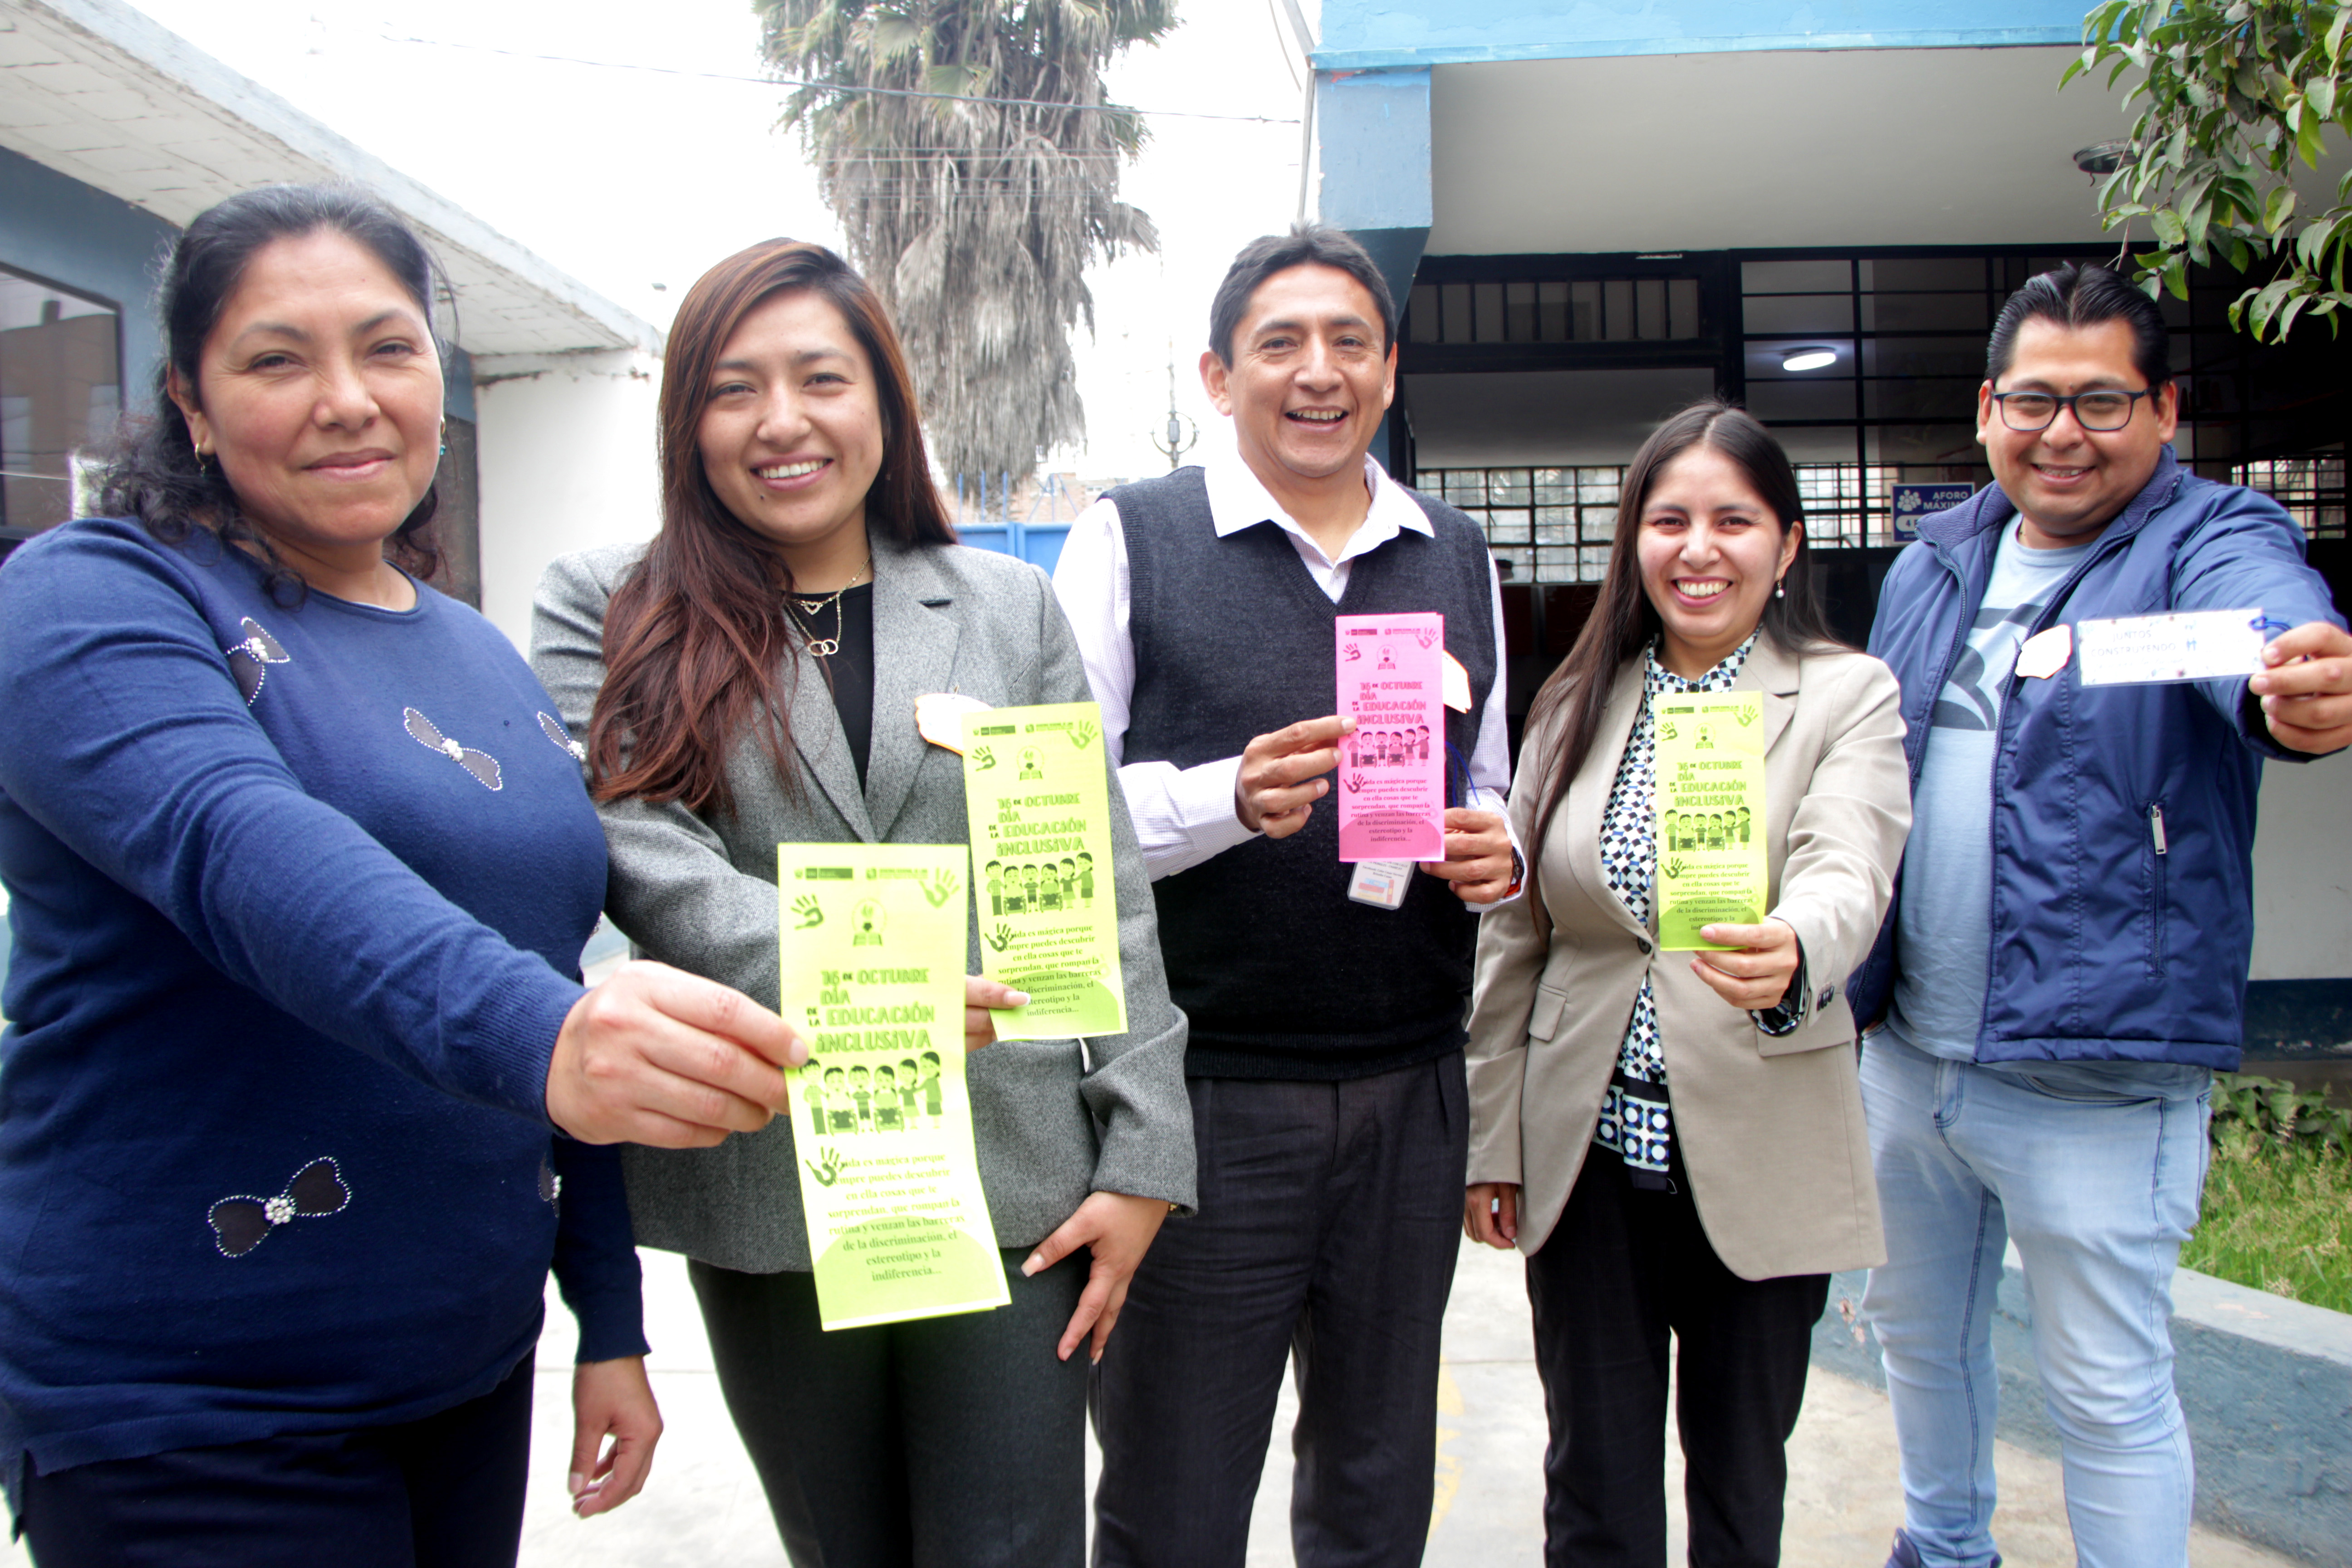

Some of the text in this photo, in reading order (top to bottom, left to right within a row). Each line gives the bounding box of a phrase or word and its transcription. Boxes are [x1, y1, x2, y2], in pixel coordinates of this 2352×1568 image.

[1933, 491, 1968, 500] AFORO
[2112, 630, 2152, 642] JUNTOS
[2091, 642, 2176, 657] CONSTRUYENDO
[1381, 681, 1422, 690] OCTUBRE
[1360, 691, 1377, 701] DÍA
[1677, 762, 1688, 770] 16
[1699, 761, 1742, 770] OCTUBRE
[1677, 771, 1695, 781] DÍA
[998, 799, 1011, 809] 16
[1024, 793, 1080, 807] OCTUBRE
[998, 809, 1020, 823] DÍA
[1066, 926, 1092, 934] porque
[1031, 939, 1057, 949] puedes
[1059, 936, 1095, 944] descubrir
[821, 970, 839, 985] 16
[858, 969, 929, 984] OCTUBRE
[821, 985, 850, 1004] DÍA
[876, 1156, 909, 1167] mágica
[912, 1155, 945, 1165] porque
[869, 1172, 902, 1184] puedes
[905, 1169, 949, 1179] descubrir
[861, 1190, 877, 1199] ella
[909, 1188, 925, 1196] que
[892, 1205, 907, 1215] que
[911, 1201, 949, 1210] rompan
[951, 1198, 960, 1207] la
[829, 1217, 965, 1235] rutina y venzan las barreras
[843, 1240, 854, 1250] de
[857, 1239, 867, 1250] la
[948, 1230, 957, 1240] el
[866, 1248, 941, 1265] estereotipo y la
